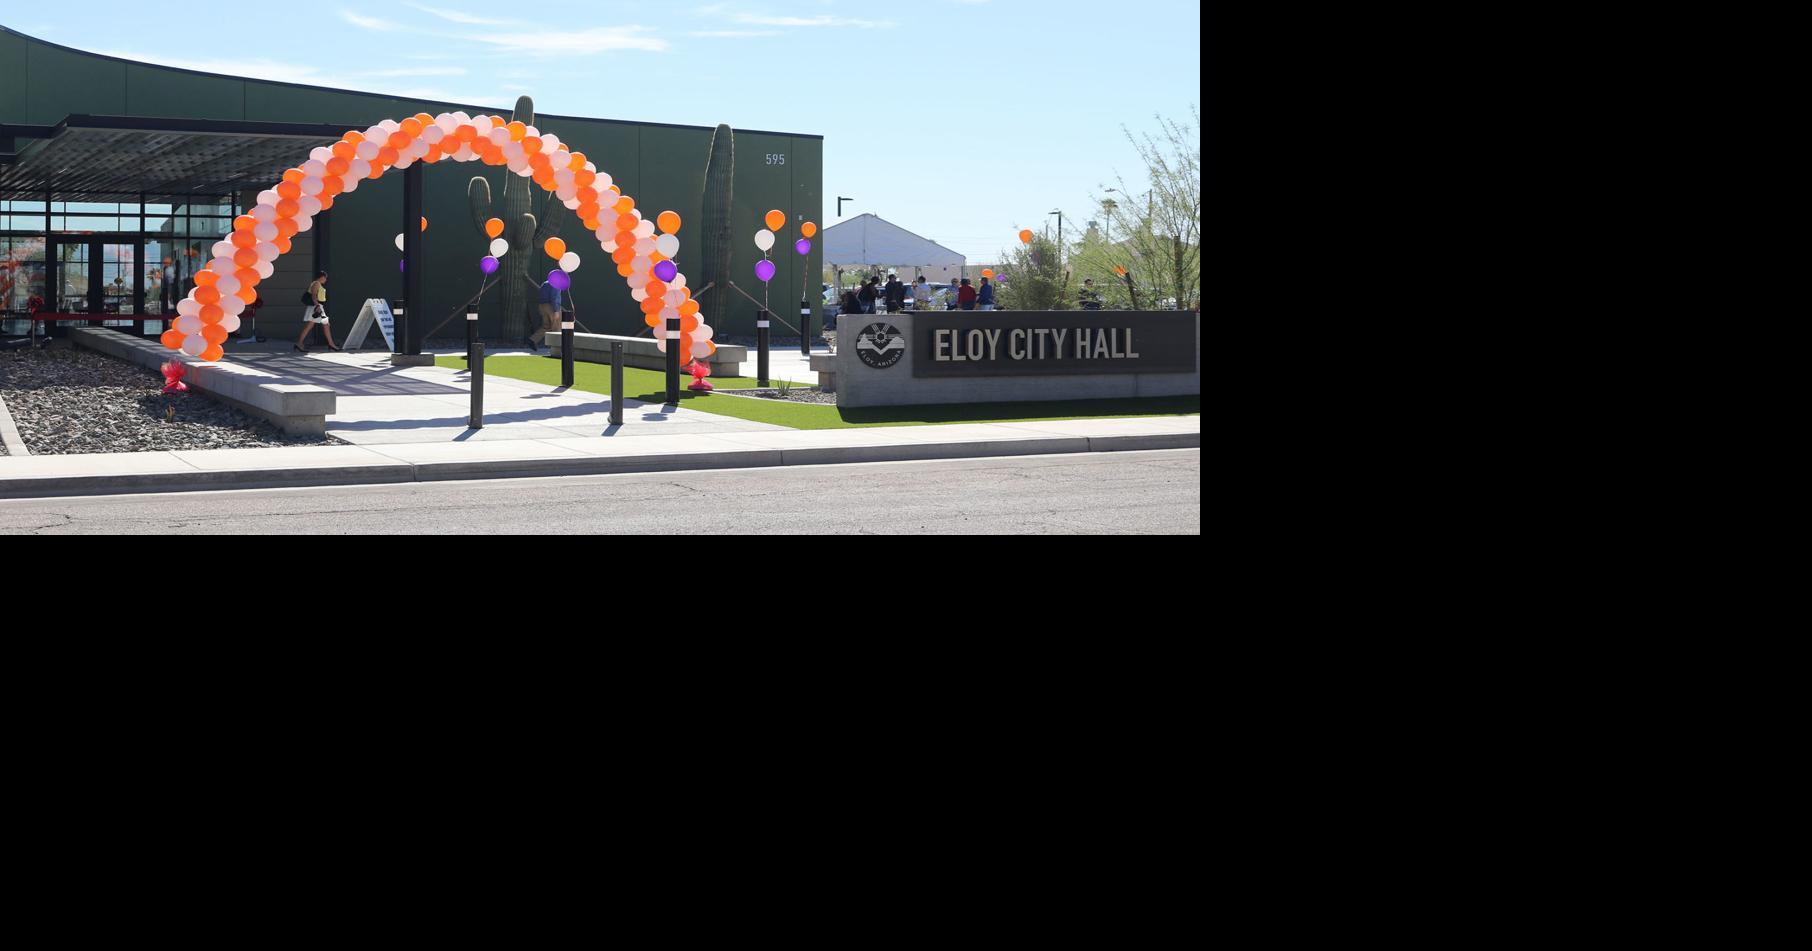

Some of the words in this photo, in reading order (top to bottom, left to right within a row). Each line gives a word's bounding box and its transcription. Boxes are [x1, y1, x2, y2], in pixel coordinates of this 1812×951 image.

[766, 153, 785, 165] 595
[935, 329, 1001, 361] ELOY
[1010, 328, 1067, 360] CITY
[1076, 327, 1139, 359] HALL
